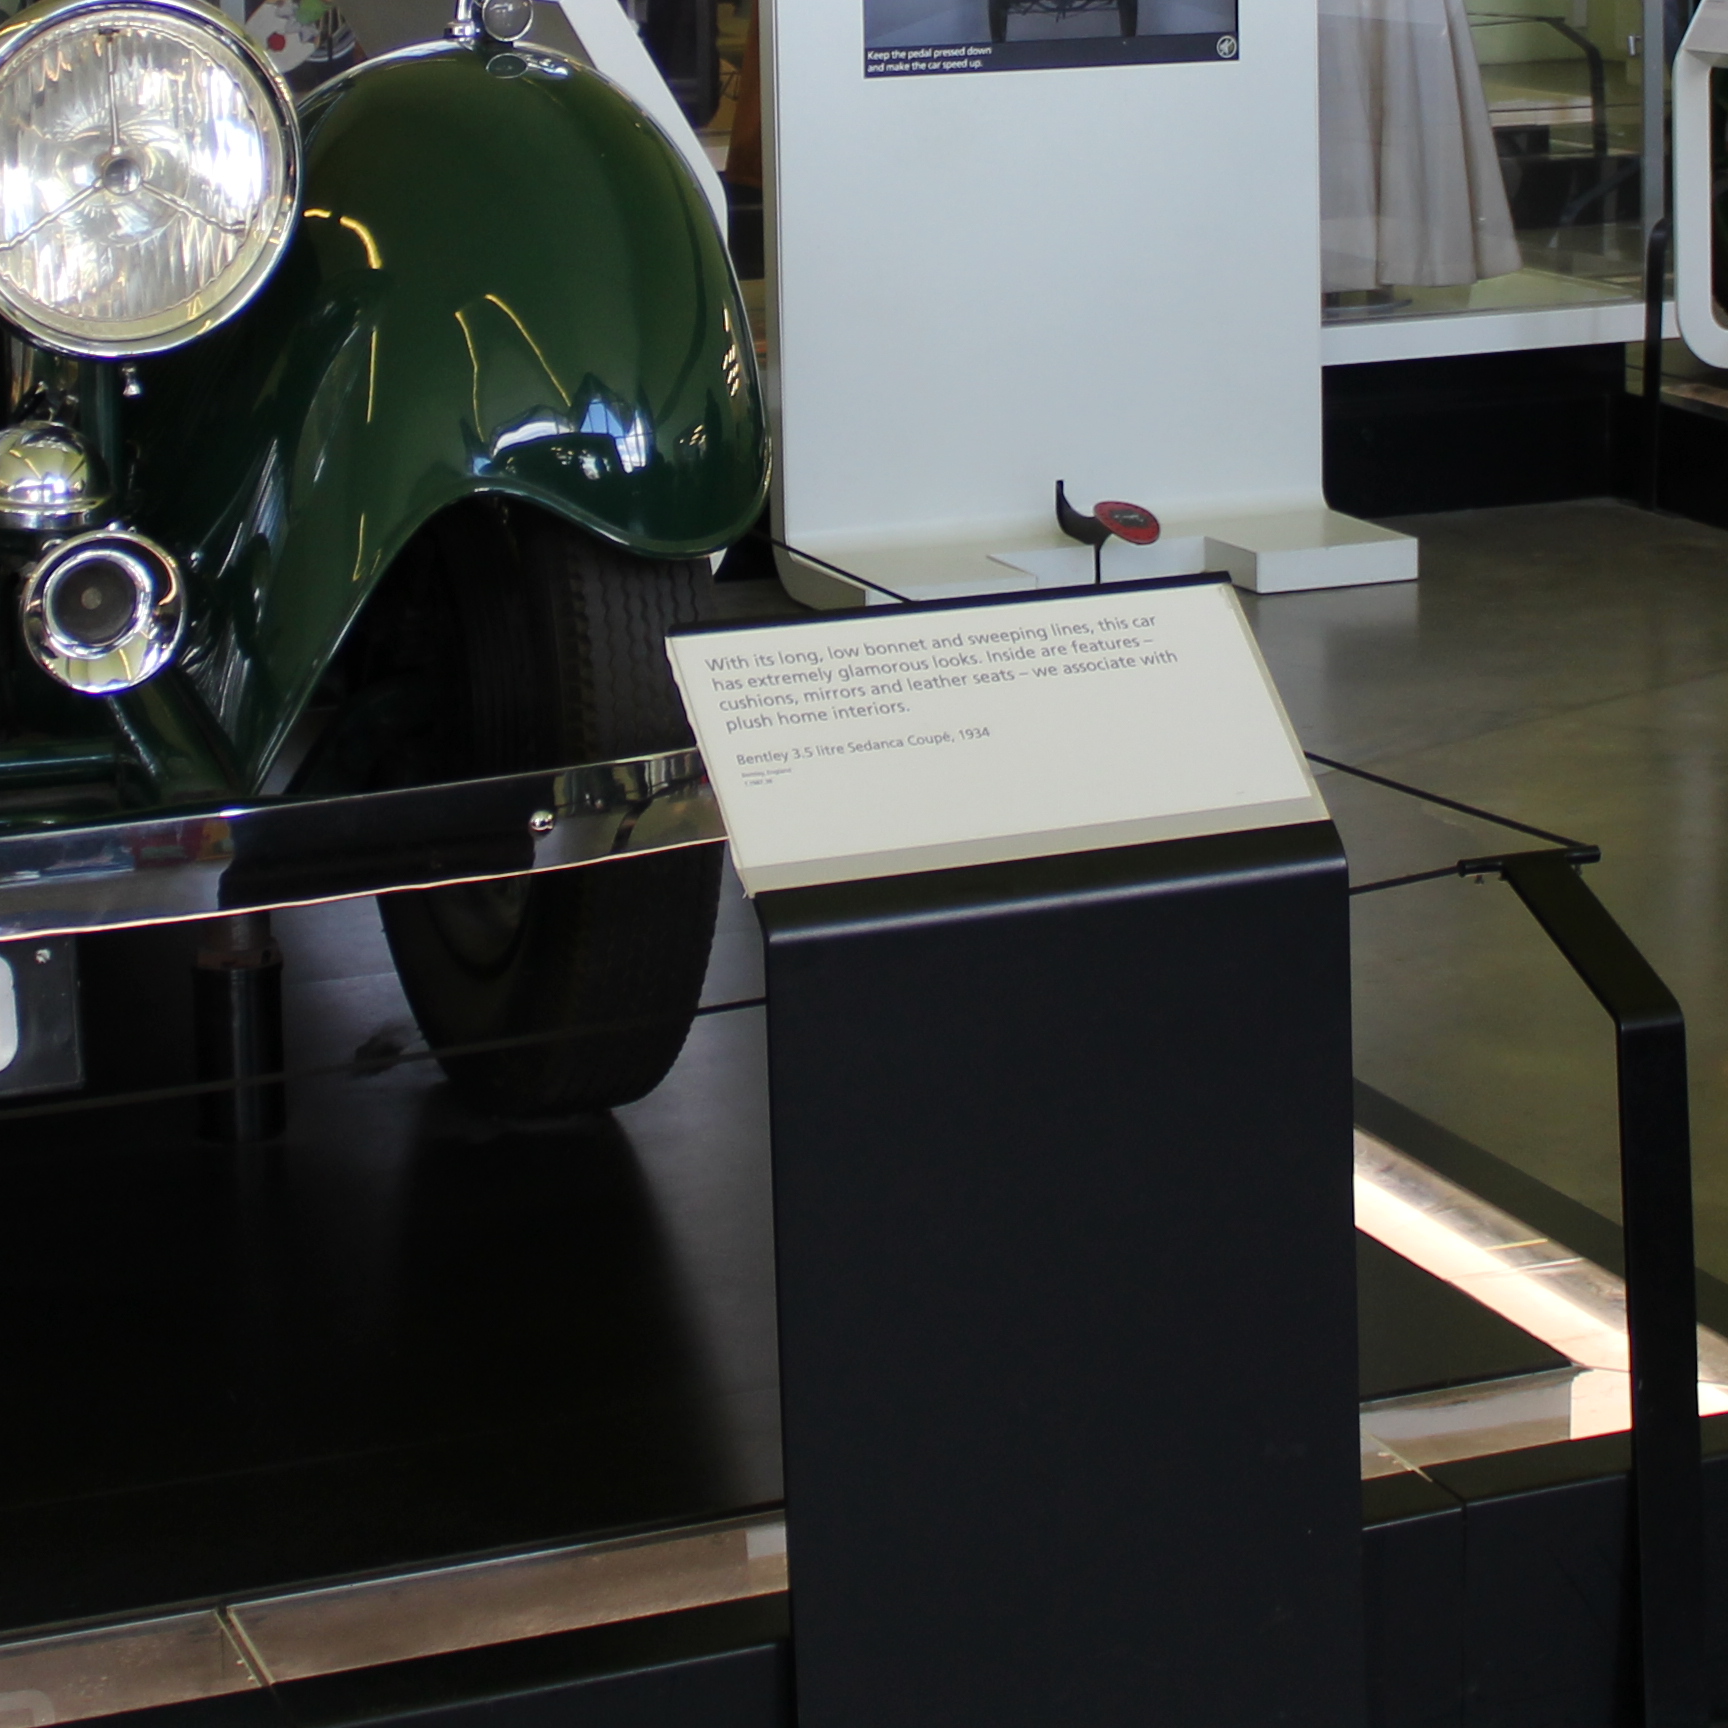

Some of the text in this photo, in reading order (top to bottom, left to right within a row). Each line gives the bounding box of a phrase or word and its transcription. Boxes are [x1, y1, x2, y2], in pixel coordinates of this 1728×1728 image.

[868, 46, 991, 61] Keep the pedal pressed down
[868, 59, 983, 72] and make the car speed up.
[705, 614, 1156, 672] With its long, low bonnet and sweeping lines, this car
[712, 678, 743, 692] has
[747, 667, 833, 688] extremely
[838, 659, 929, 682] glamorous
[932, 652, 982, 669] looks.
[986, 643, 1036, 664] Inside
[1041, 644, 1068, 658] are
[1071, 636, 1140, 654] features
[719, 692, 799, 712] cushions,
[803, 685, 866, 703] mirrors
[870, 679, 903, 696] and
[907, 674, 967, 692] leather
[973, 668, 1015, 685] seats
[1032, 665, 1058, 678] we
[1063, 656, 1136, 675] associate
[1140, 649, 1179, 666] with
[725, 701, 911, 734] plush home interiors.
[736, 749, 789, 766] Bentley
[793, 746, 813, 760] 3.5
[816, 743, 845, 756] litre
[848, 738, 904, 753] Sedanca
[958, 727, 990, 741] 1934
